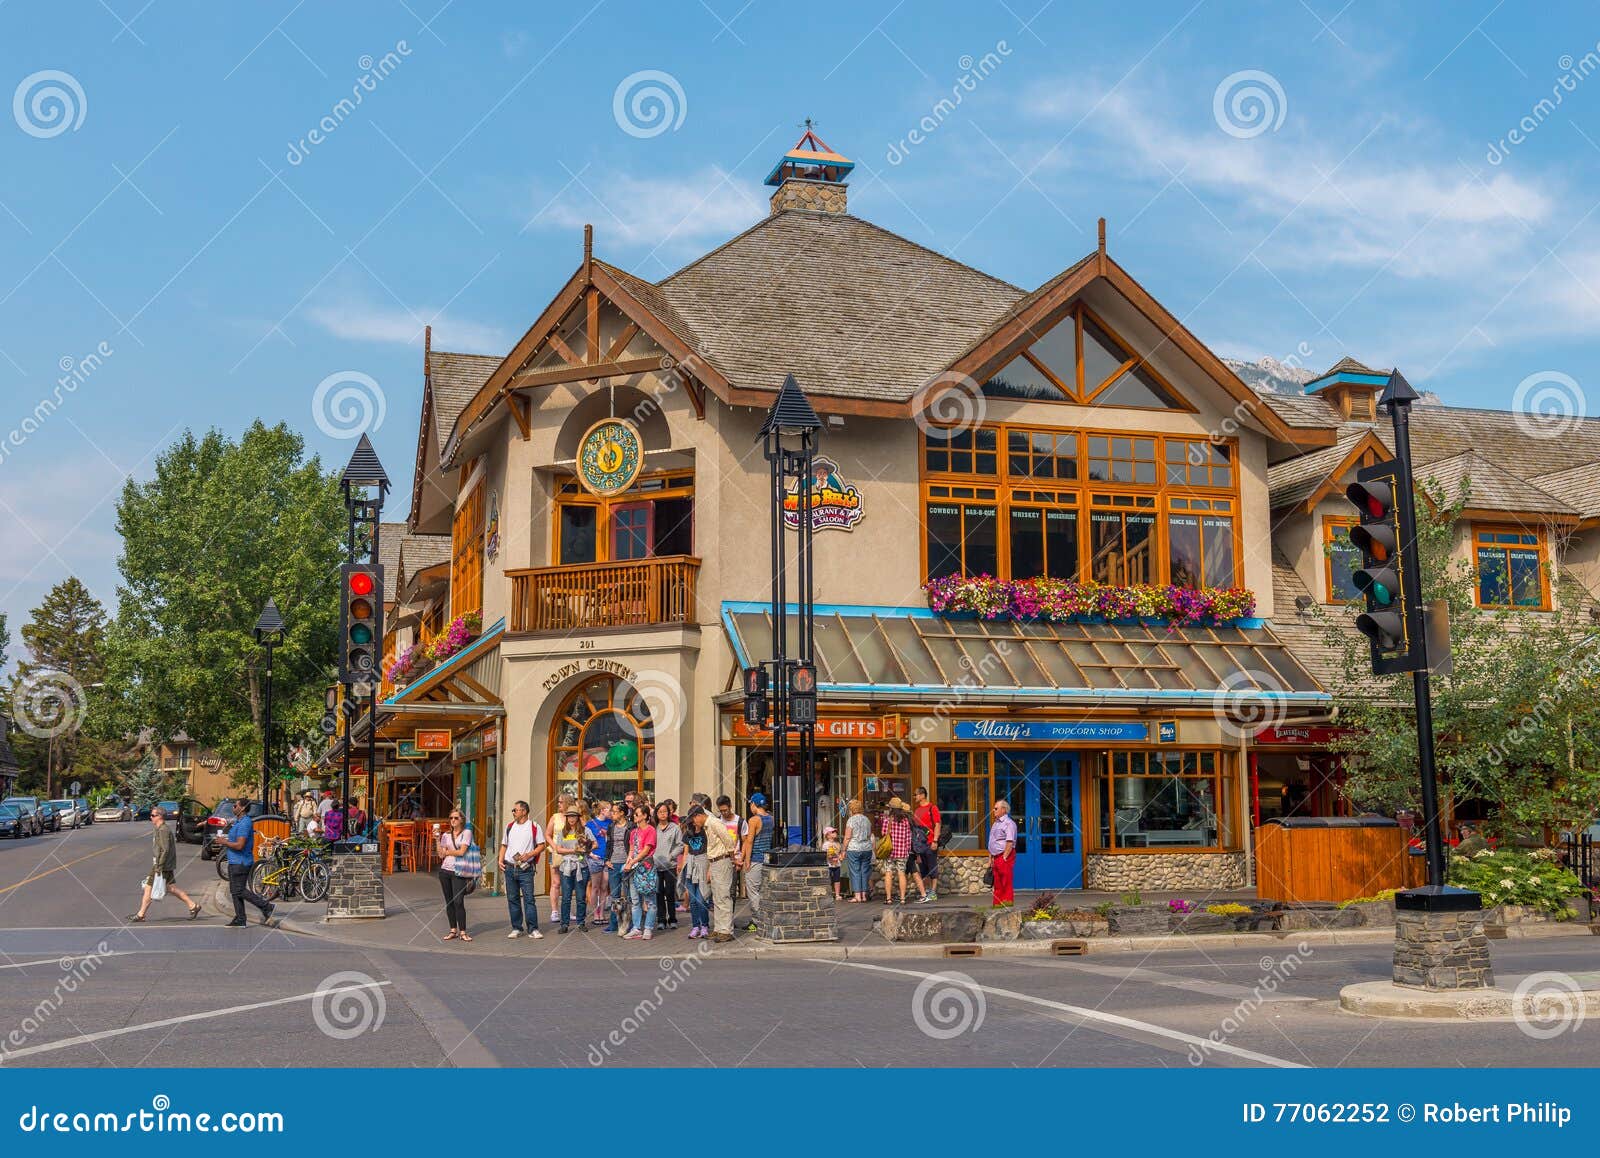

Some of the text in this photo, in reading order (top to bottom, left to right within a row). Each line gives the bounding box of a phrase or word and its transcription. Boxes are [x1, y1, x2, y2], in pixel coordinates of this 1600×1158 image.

[783, 493, 821, 511] WD
[929, 507, 959, 515] COWBOYS
[965, 508, 996, 517] BAR-B-QUE
[1012, 511, 1040, 519] WHISKEY
[818, 516, 845, 524] SALOON
[579, 640, 595, 649] 201
[542, 660, 581, 691] TOWN
[830, 721, 876, 735] GIFTS
[973, 719, 1123, 741] Mary's POPCORN SHOP
[199, 755, 222, 772] Banff
